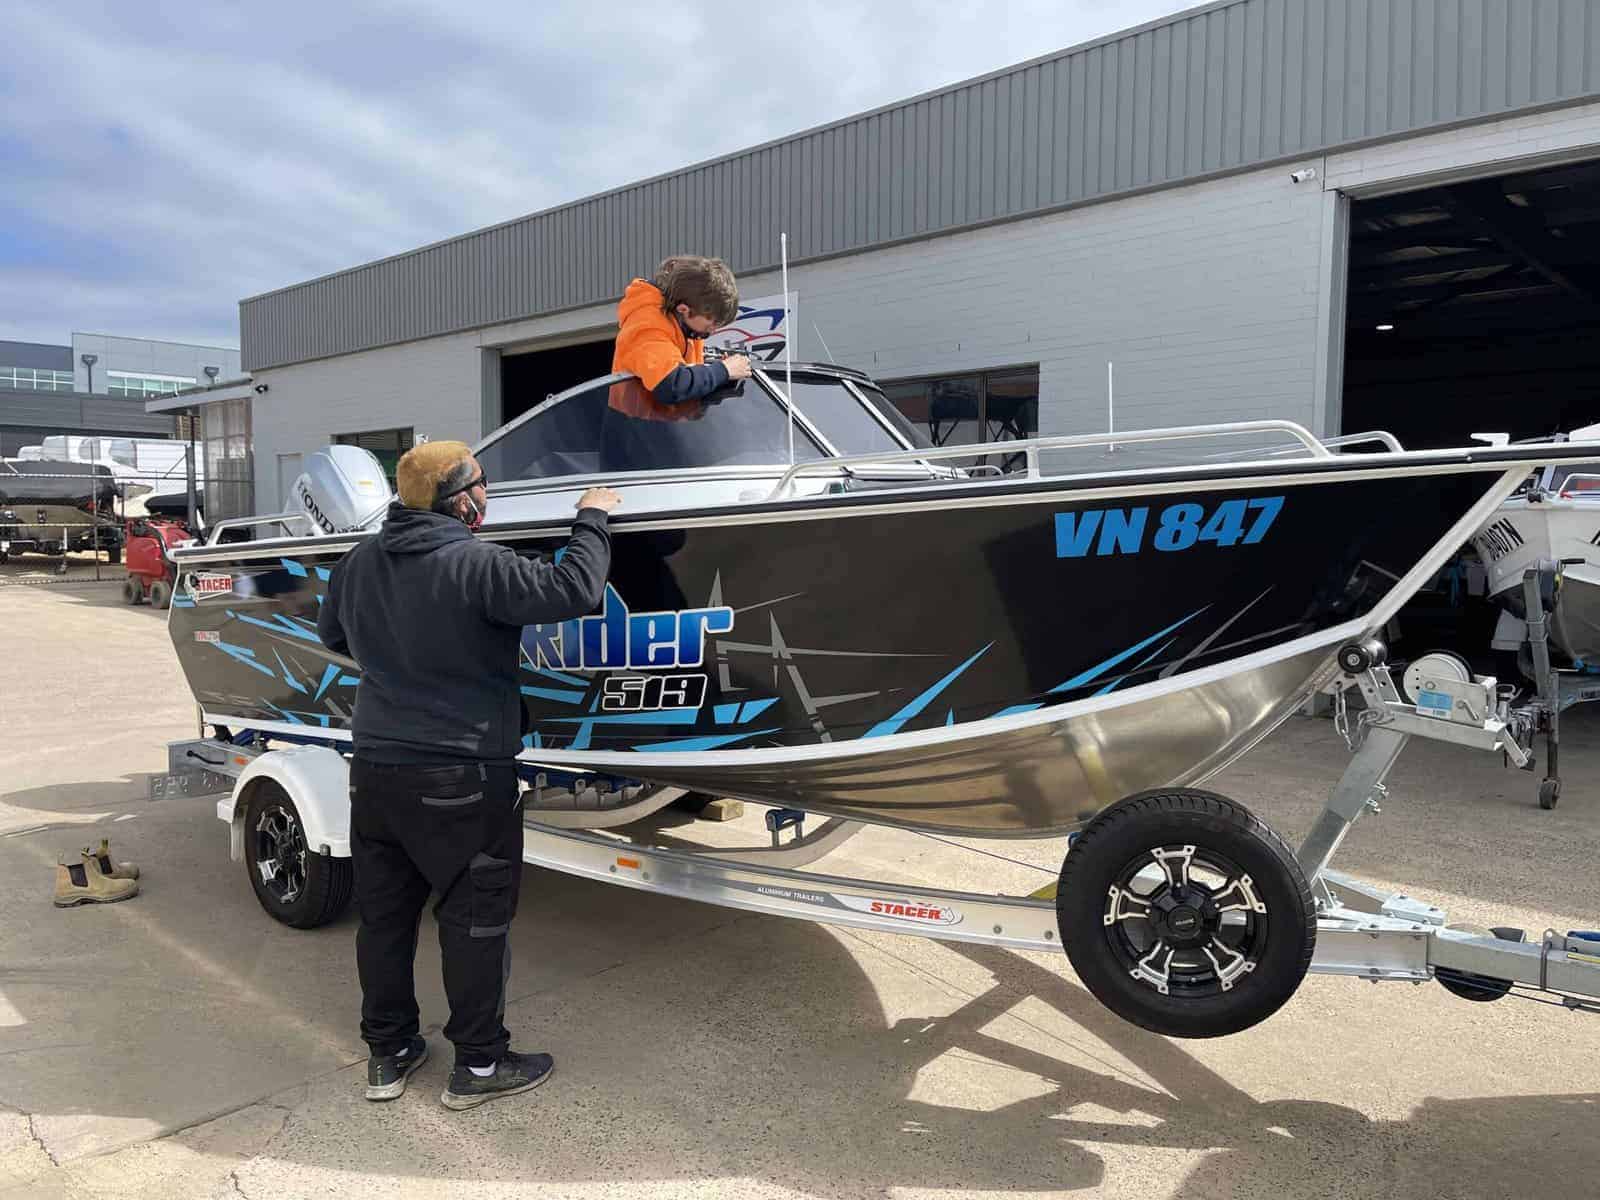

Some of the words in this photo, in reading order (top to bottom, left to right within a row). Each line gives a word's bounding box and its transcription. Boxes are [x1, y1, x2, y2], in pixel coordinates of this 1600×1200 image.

[1054, 506, 1150, 558] VN
[1153, 496, 1286, 552] 847
[602, 673, 708, 711] 519
[870, 902, 942, 920] STACER
